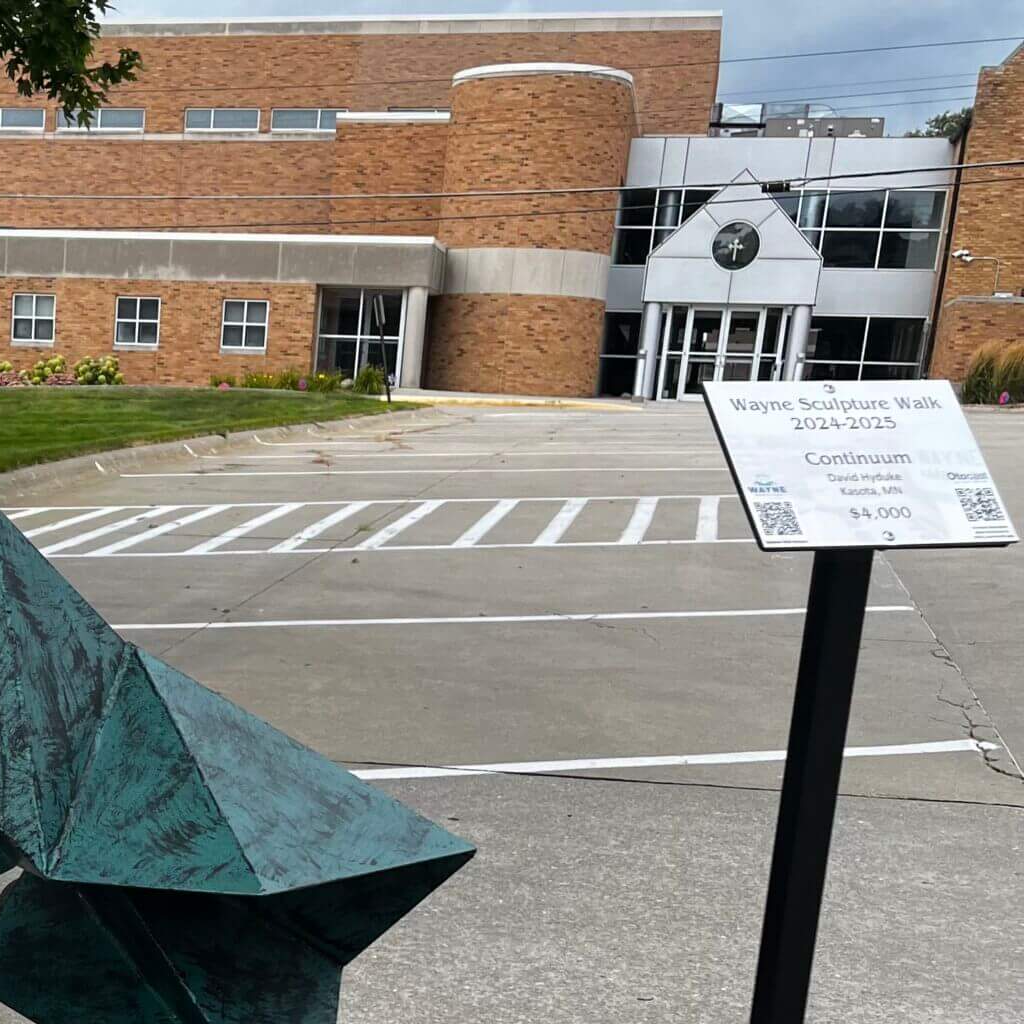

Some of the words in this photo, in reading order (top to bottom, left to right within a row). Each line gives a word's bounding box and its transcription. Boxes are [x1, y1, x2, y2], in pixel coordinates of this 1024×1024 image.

[730, 397, 794, 414] Wayne
[798, 396, 890, 413] Sculpture
[894, 396, 942, 410] Walk
[791, 416, 897, 431] 2024-2025
[804, 451, 912, 466] Continuum
[827, 472, 858, 482] David
[849, 506, 912, 520] $4,000
